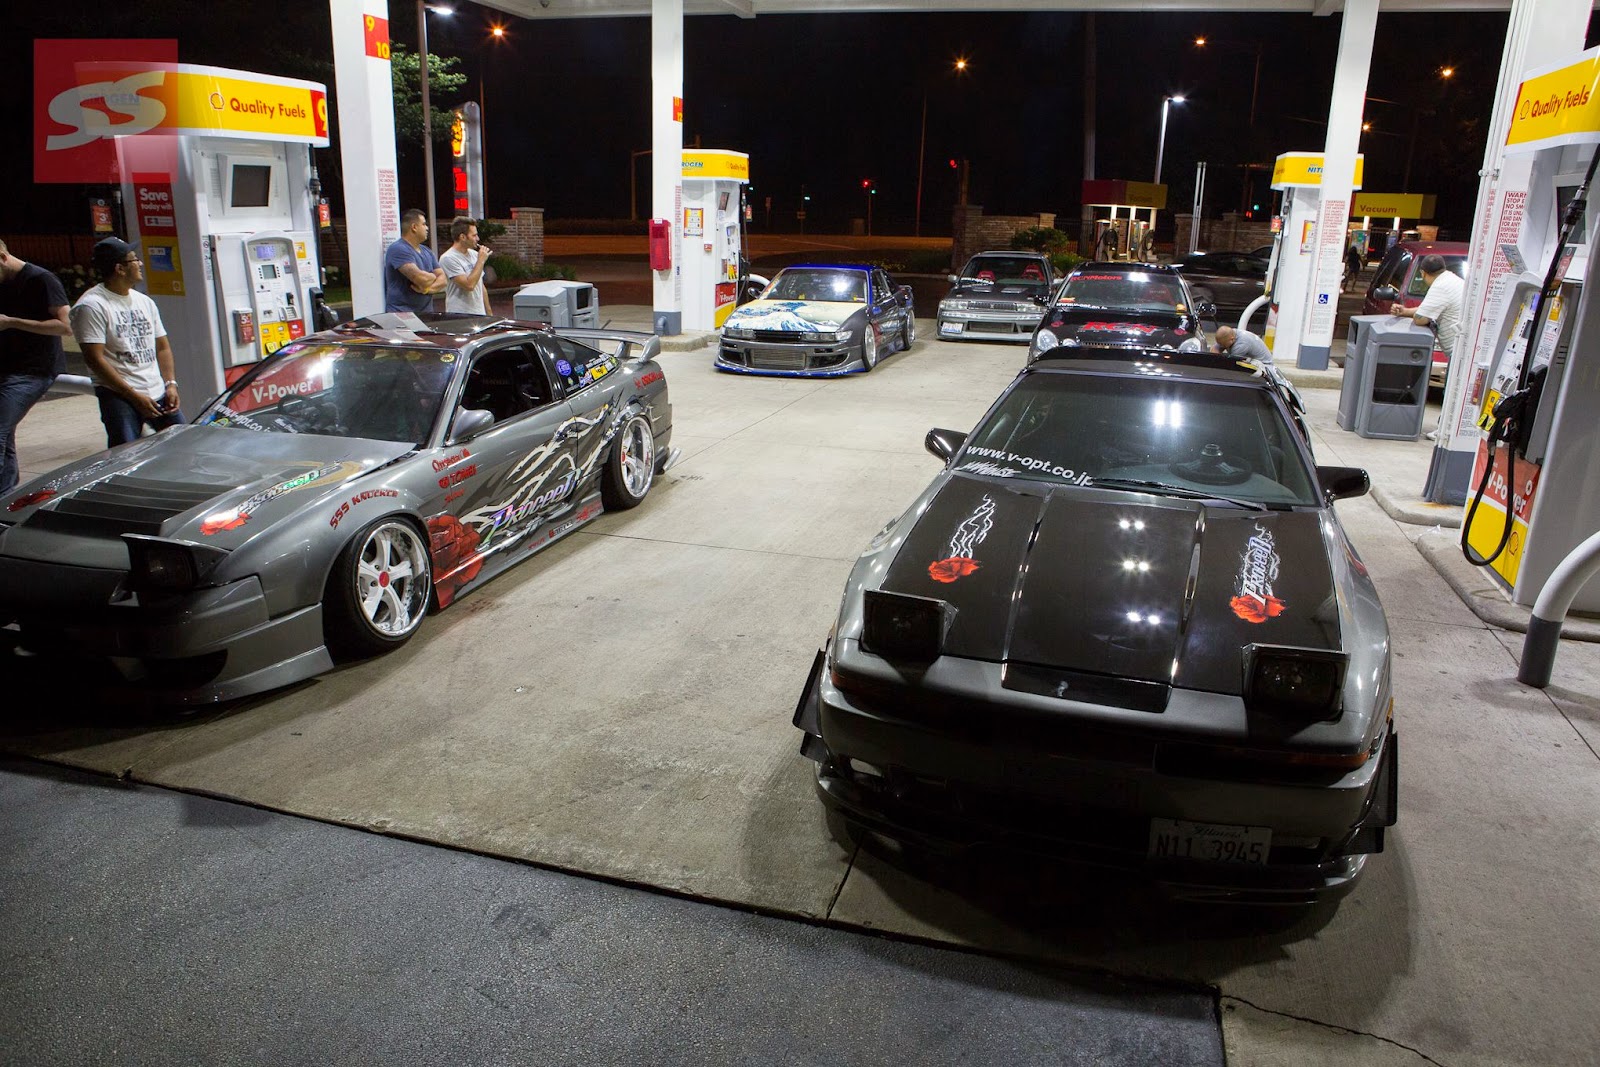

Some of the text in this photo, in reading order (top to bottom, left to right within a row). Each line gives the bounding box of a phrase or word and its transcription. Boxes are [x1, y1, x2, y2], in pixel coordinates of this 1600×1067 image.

[366, 15, 375, 32] 9
[376, 41, 391, 59] 10
[229, 97, 307, 120] Quality Fuels
[1531, 84, 1590, 118] Quality Fuels
[139, 187, 169, 202] Save
[1360, 204, 1397, 213] Vacuum
[252, 380, 323, 404] V-Power
[966, 444, 1094, 487] www.v-opt.co.jp
[1487, 470, 1527, 514] V-Poer
[1211, 839, 1264, 865] 3945
